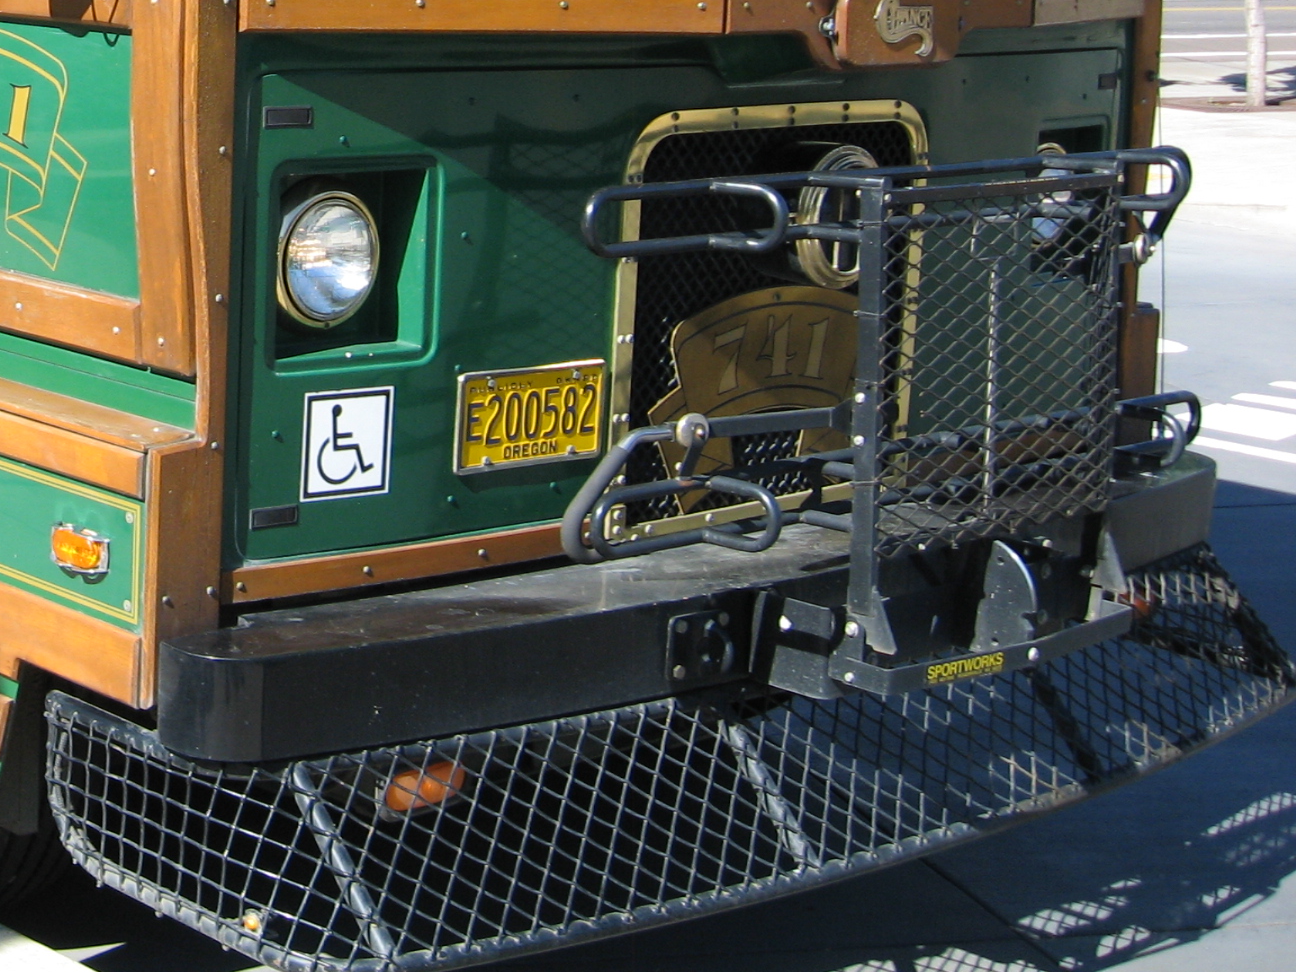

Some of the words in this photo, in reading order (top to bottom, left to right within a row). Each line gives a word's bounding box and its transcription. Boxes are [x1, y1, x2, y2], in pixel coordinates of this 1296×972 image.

[712, 313, 831, 396] 741
[466, 383, 597, 447] E200582
[504, 439, 558, 460] OREGON
[927, 651, 1005, 681] SPORTWORKS
